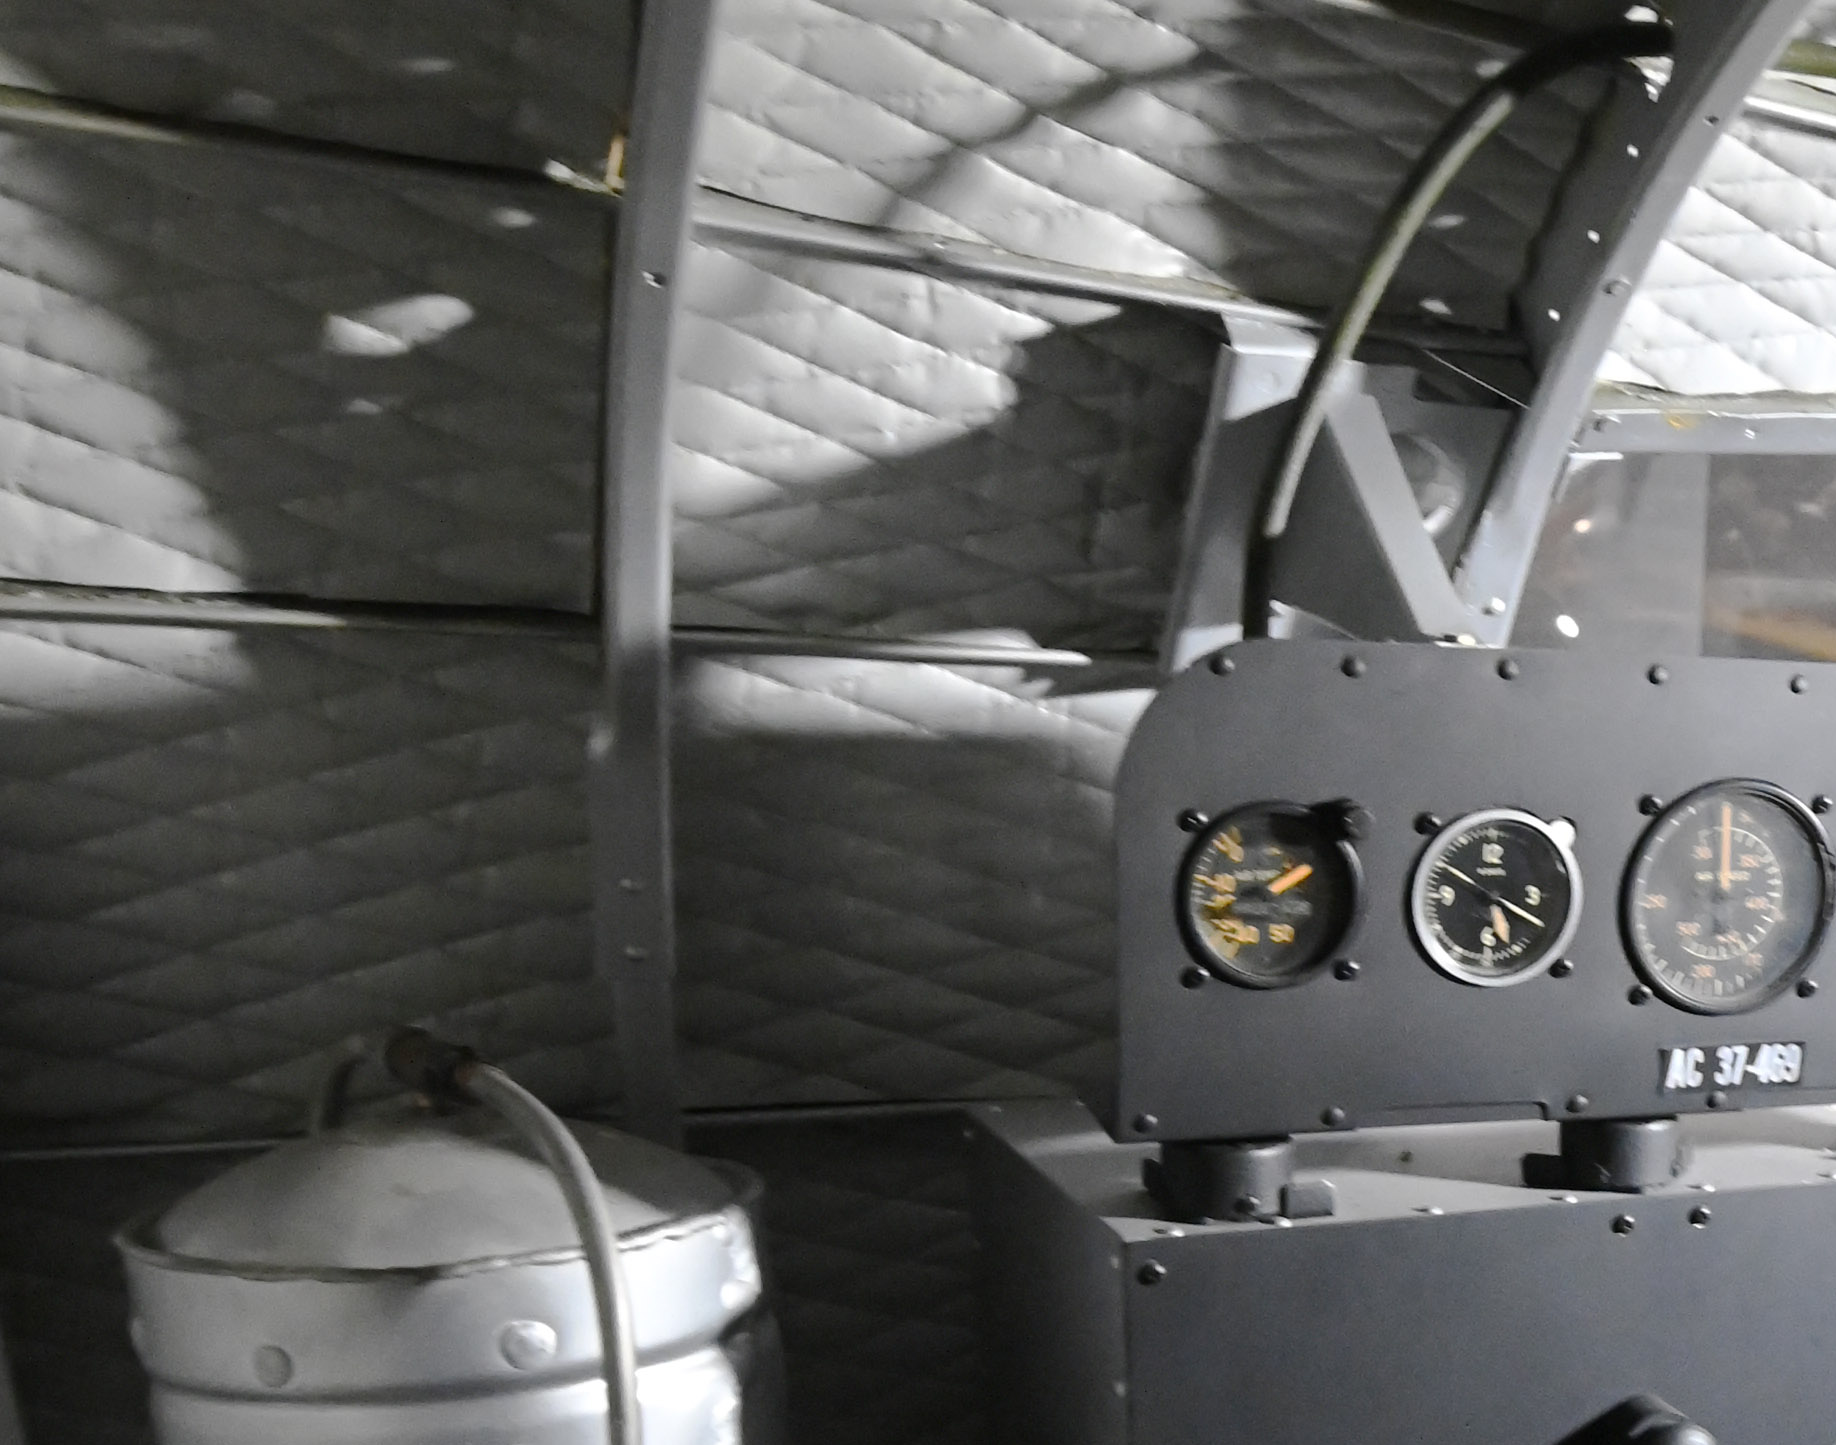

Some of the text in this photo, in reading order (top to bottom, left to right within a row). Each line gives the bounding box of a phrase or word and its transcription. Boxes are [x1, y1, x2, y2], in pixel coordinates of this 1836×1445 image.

[1482, 842, 1505, 864] 12
[1439, 885, 1456, 906] 9
[1525, 885, 1542, 906] 3
[1480, 926, 1497, 947] 6
[1665, 1043, 1803, 1089] AC 37-469
